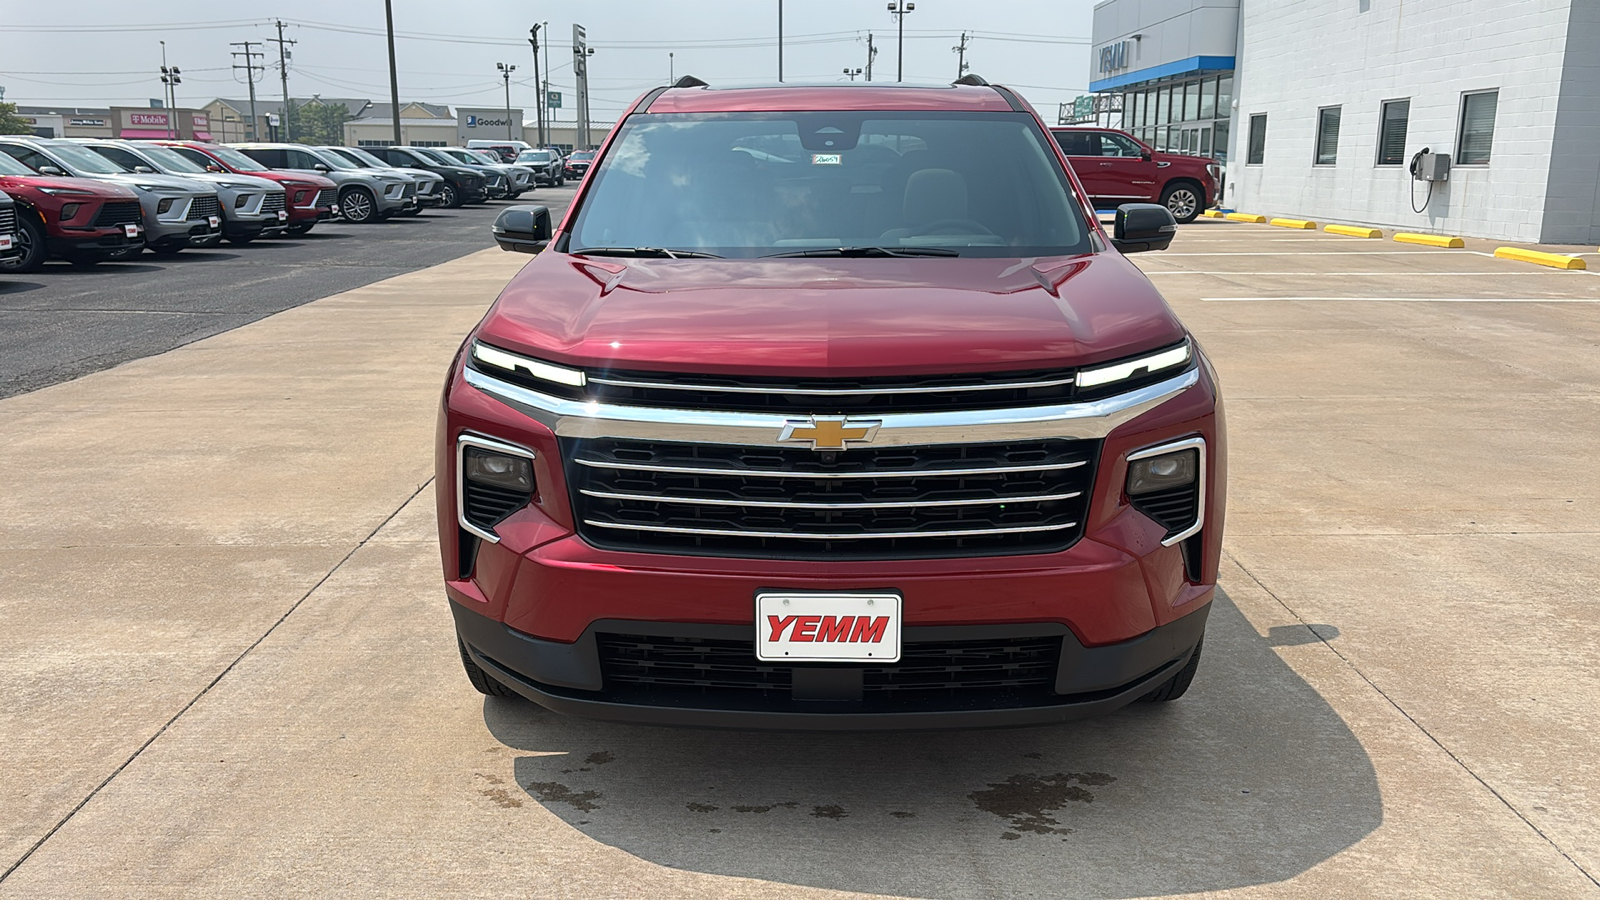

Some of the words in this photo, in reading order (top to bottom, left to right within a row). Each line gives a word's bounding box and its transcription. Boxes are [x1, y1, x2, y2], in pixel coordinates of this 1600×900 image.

[1099, 41, 1128, 73] YEMM
[140, 115, 166, 124] Mobile
[767, 615, 890, 643] YEMM
